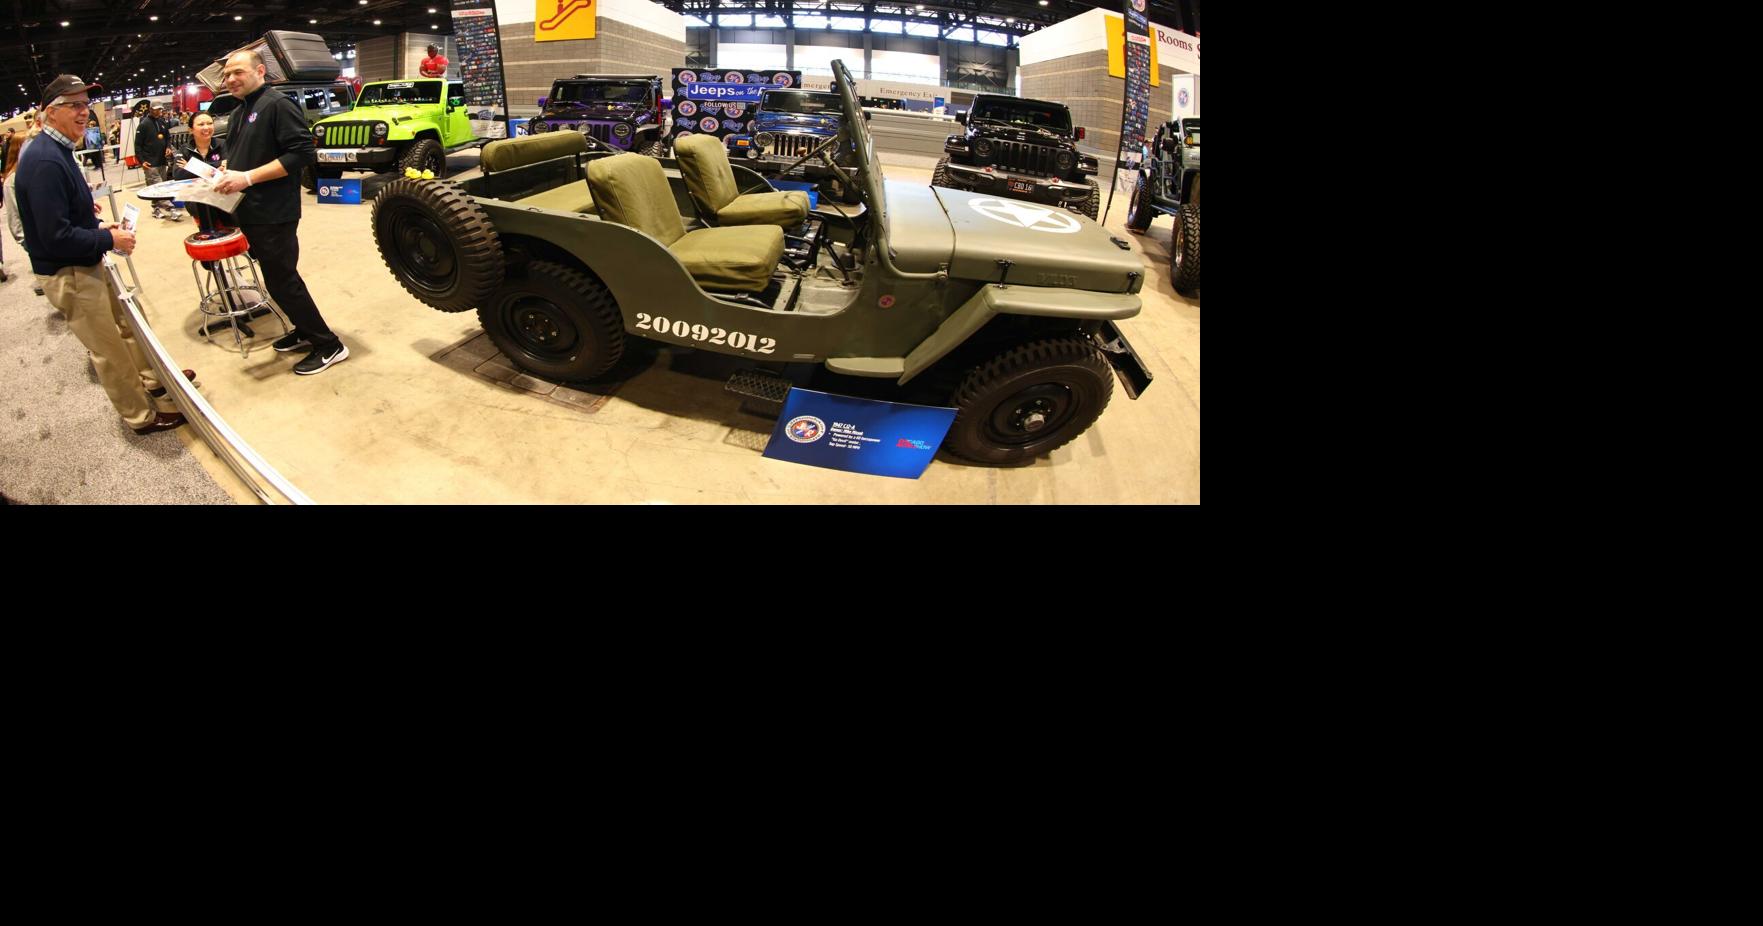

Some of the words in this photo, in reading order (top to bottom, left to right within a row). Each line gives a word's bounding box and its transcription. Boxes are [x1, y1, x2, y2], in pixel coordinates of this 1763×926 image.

[1157, 30, 1193, 51] Rooms
[690, 85, 735, 97] Jeeps
[746, 87, 757, 95] the
[880, 87, 921, 97] Emergency
[635, 312, 776, 354] 20092012
